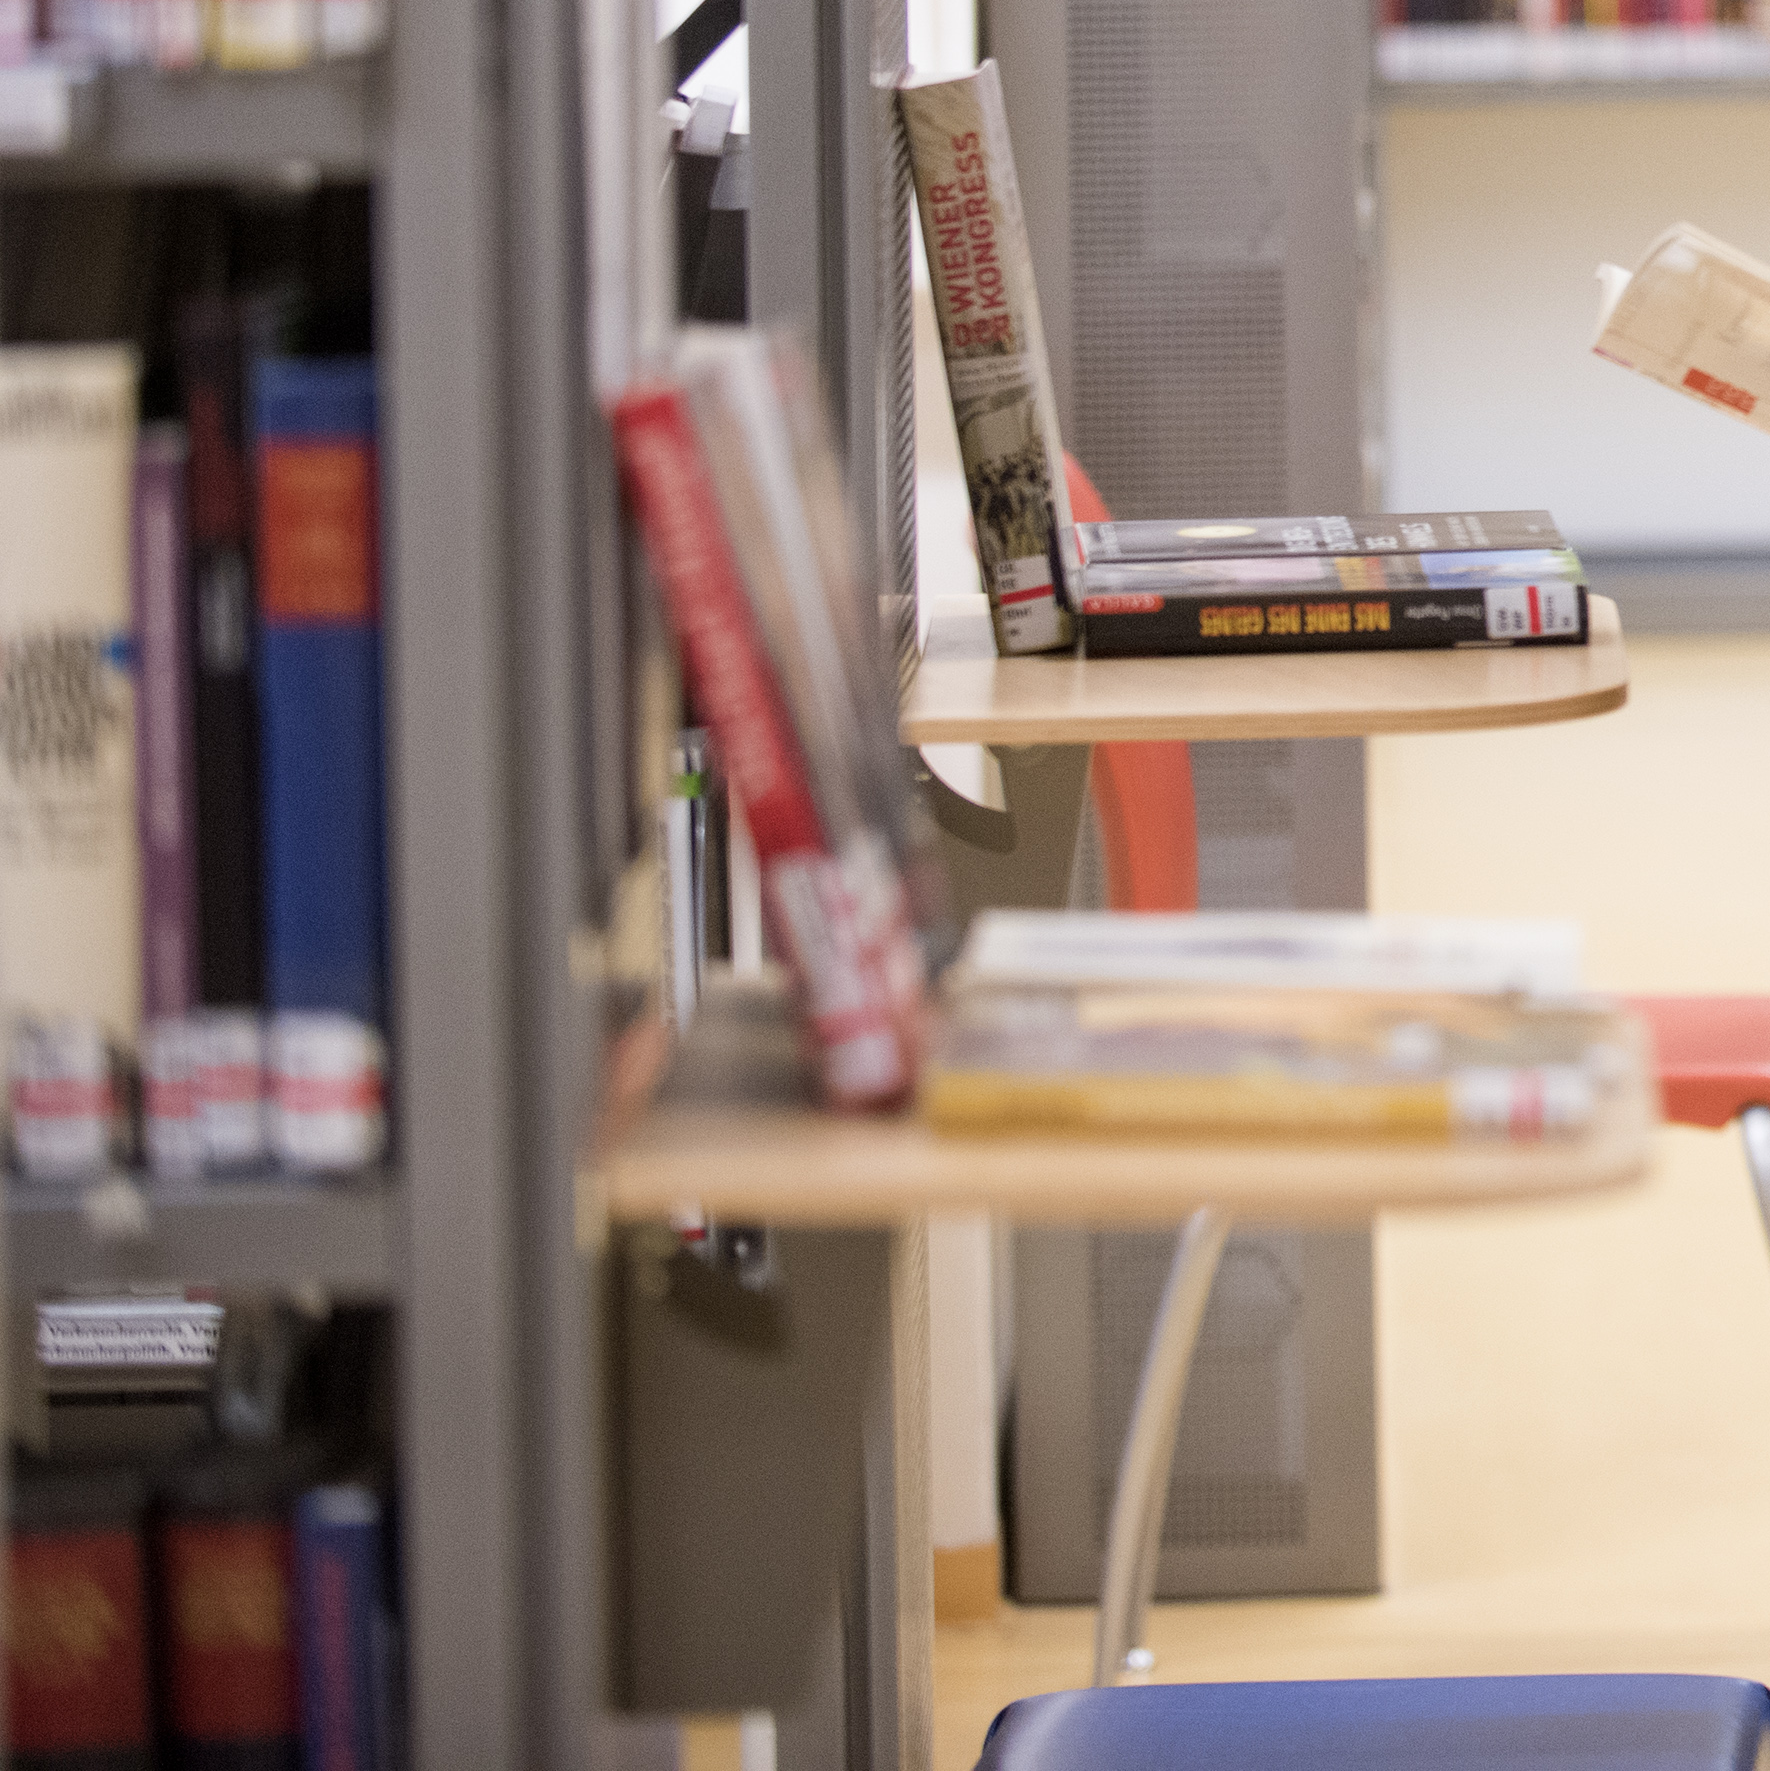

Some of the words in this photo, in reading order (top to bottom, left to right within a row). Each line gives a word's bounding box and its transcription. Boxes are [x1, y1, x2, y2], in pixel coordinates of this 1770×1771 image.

[952, 131, 1006, 312] KONGRESS
[930, 182, 975, 314] WIENER
[1266, 606, 1301, 636] DES
[1303, 604, 1351, 634] ENDE
[1353, 601, 1390, 632] DAS
